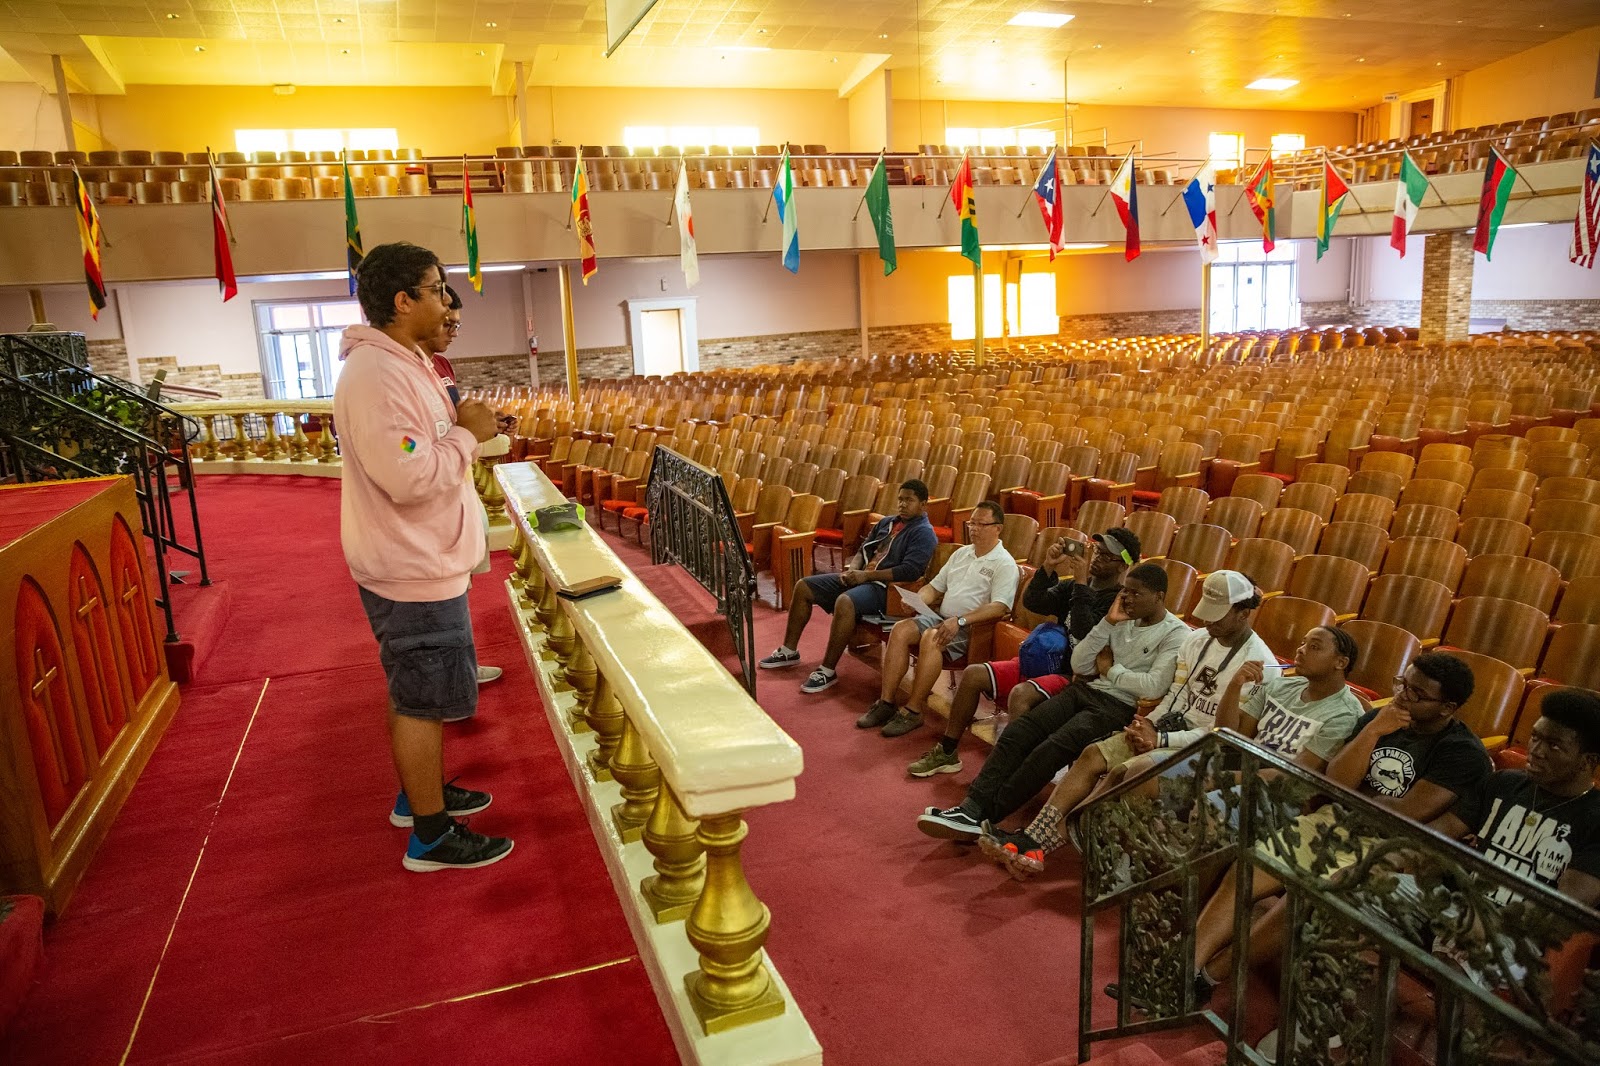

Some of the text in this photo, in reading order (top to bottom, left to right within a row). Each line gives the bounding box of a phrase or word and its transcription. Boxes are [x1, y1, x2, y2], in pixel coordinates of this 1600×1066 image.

[1260, 700, 1311, 755] TRUE
[1478, 798, 1558, 857] I AM
[1548, 851, 1565, 863] AM
